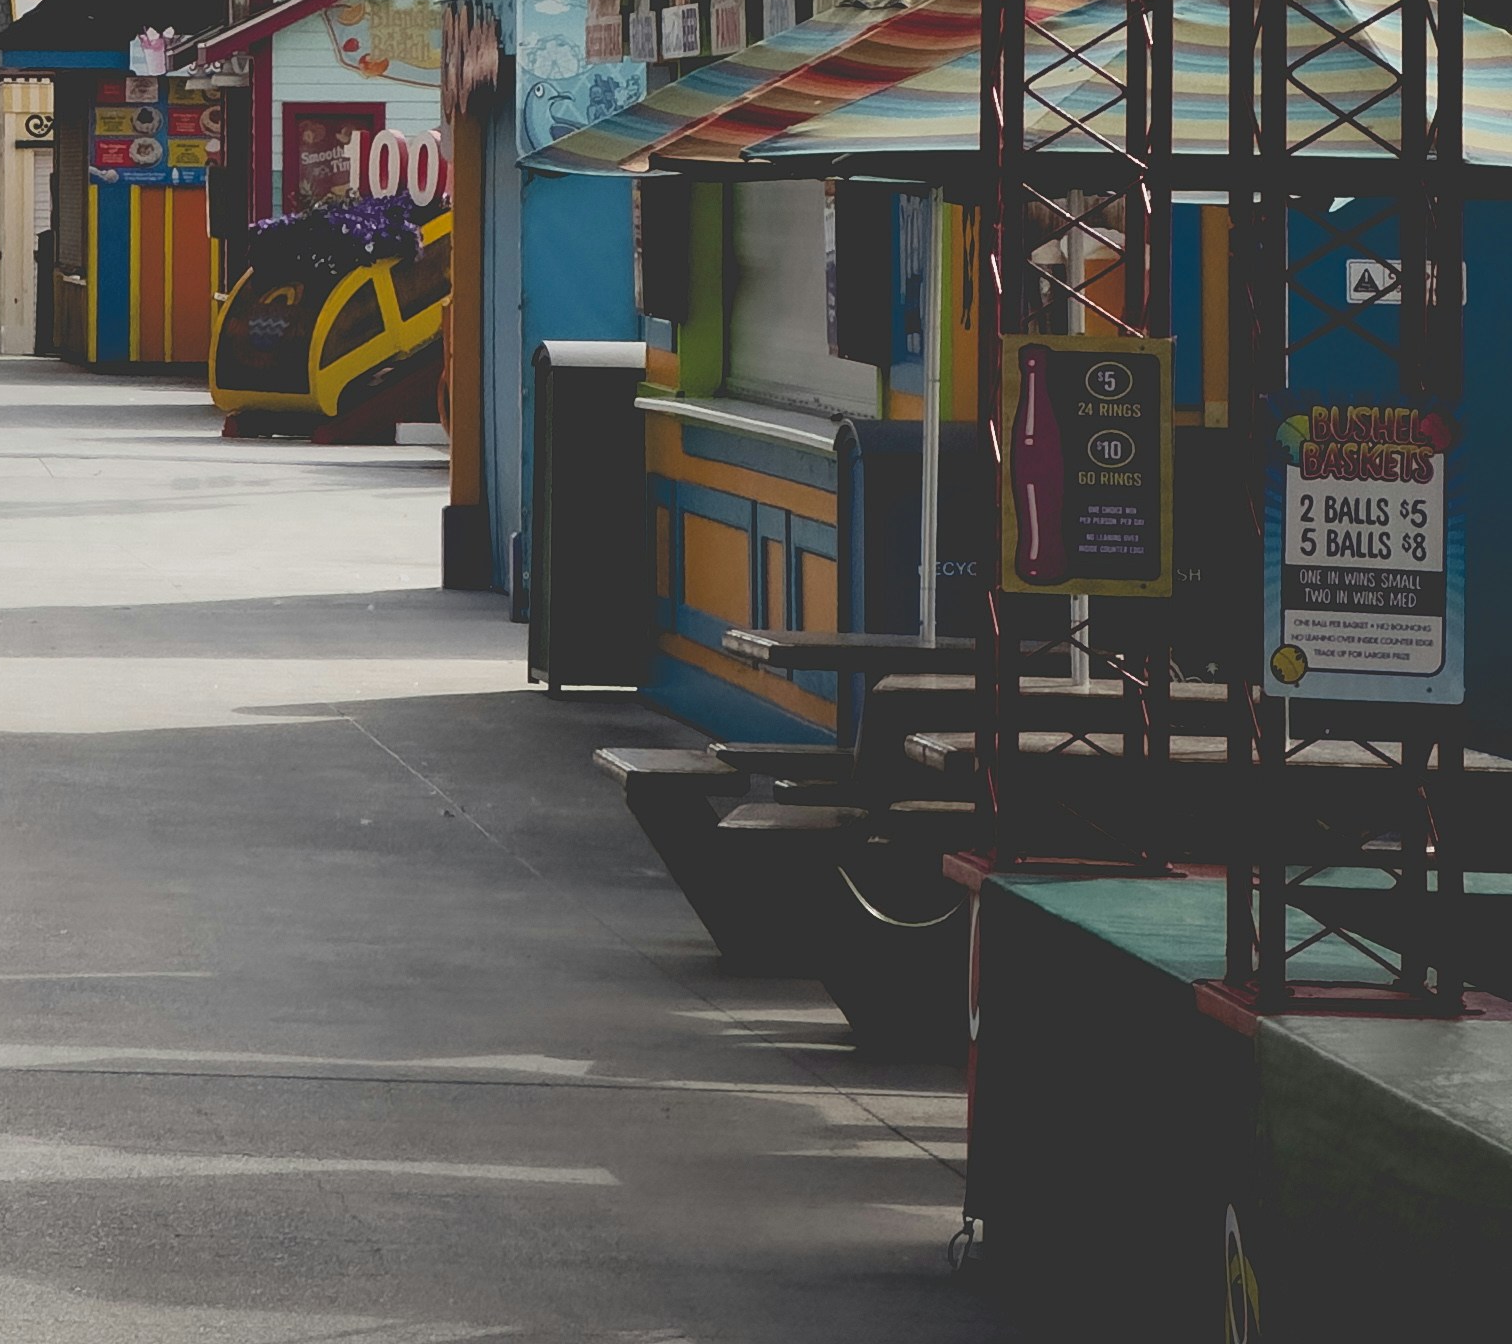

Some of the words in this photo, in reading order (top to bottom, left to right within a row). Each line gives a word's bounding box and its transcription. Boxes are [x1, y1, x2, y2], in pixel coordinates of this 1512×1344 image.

[301, 145, 346, 165] Smooth
[343, 129, 440, 207] 100
[1098, 370, 1116, 392] $5
[1078, 401, 1093, 416] 24
[1099, 402, 1142, 418] RINGS
[1311, 405, 1424, 445] BUSHEL
[1096, 440, 1122, 460] $10
[1300, 442, 1435, 484] BASKETS
[1078, 471, 1096, 486] 60
[1100, 471, 1143, 487] RINGS
[1300, 494, 1315, 523] 2
[1324, 496, 1390, 526] BALLS
[1399, 499, 1427, 528] $5
[1300, 527, 1317, 557] 5
[1326, 529, 1392, 560] BALLS
[1401, 533, 1427, 562] $8
[1299, 568, 1323, 585] ONE
[1327, 570, 1339, 585] IN
[1344, 571, 1376, 588] WINS
[1380, 572, 1422, 590] SMALL
[1304, 587, 1331, 604] TWO
[1336, 589, 1348, 605] IN
[1353, 590, 1385, 607] WINS
[1389, 592, 1417, 609] MED
[1293, 618, 1310, 627] ONE
[1311, 619, 1327, 628] BALL
[1329, 620, 1341, 628] PER
[1343, 620, 1369, 629] BASKET
[1375, 623, 1389, 631] NO
[1390, 623, 1432, 633] BOUNCING
[1291, 633, 1304, 641] NO
[1305, 634, 1336, 643] LEANING
[1336, 635, 1355, 644] OVER
[1356, 636, 1379, 645] INSIDE
[1380, 637, 1413, 647] COUNTER
[1415, 638, 1434, 648] EDGE
[1314, 648, 1336, 657] TRADE
[1337, 649, 1348, 658] UP
[1348, 649, 1363, 659] FOR
[1364, 650, 1391, 660] LARGER
[1392, 651, 1411, 661] PRIZE
